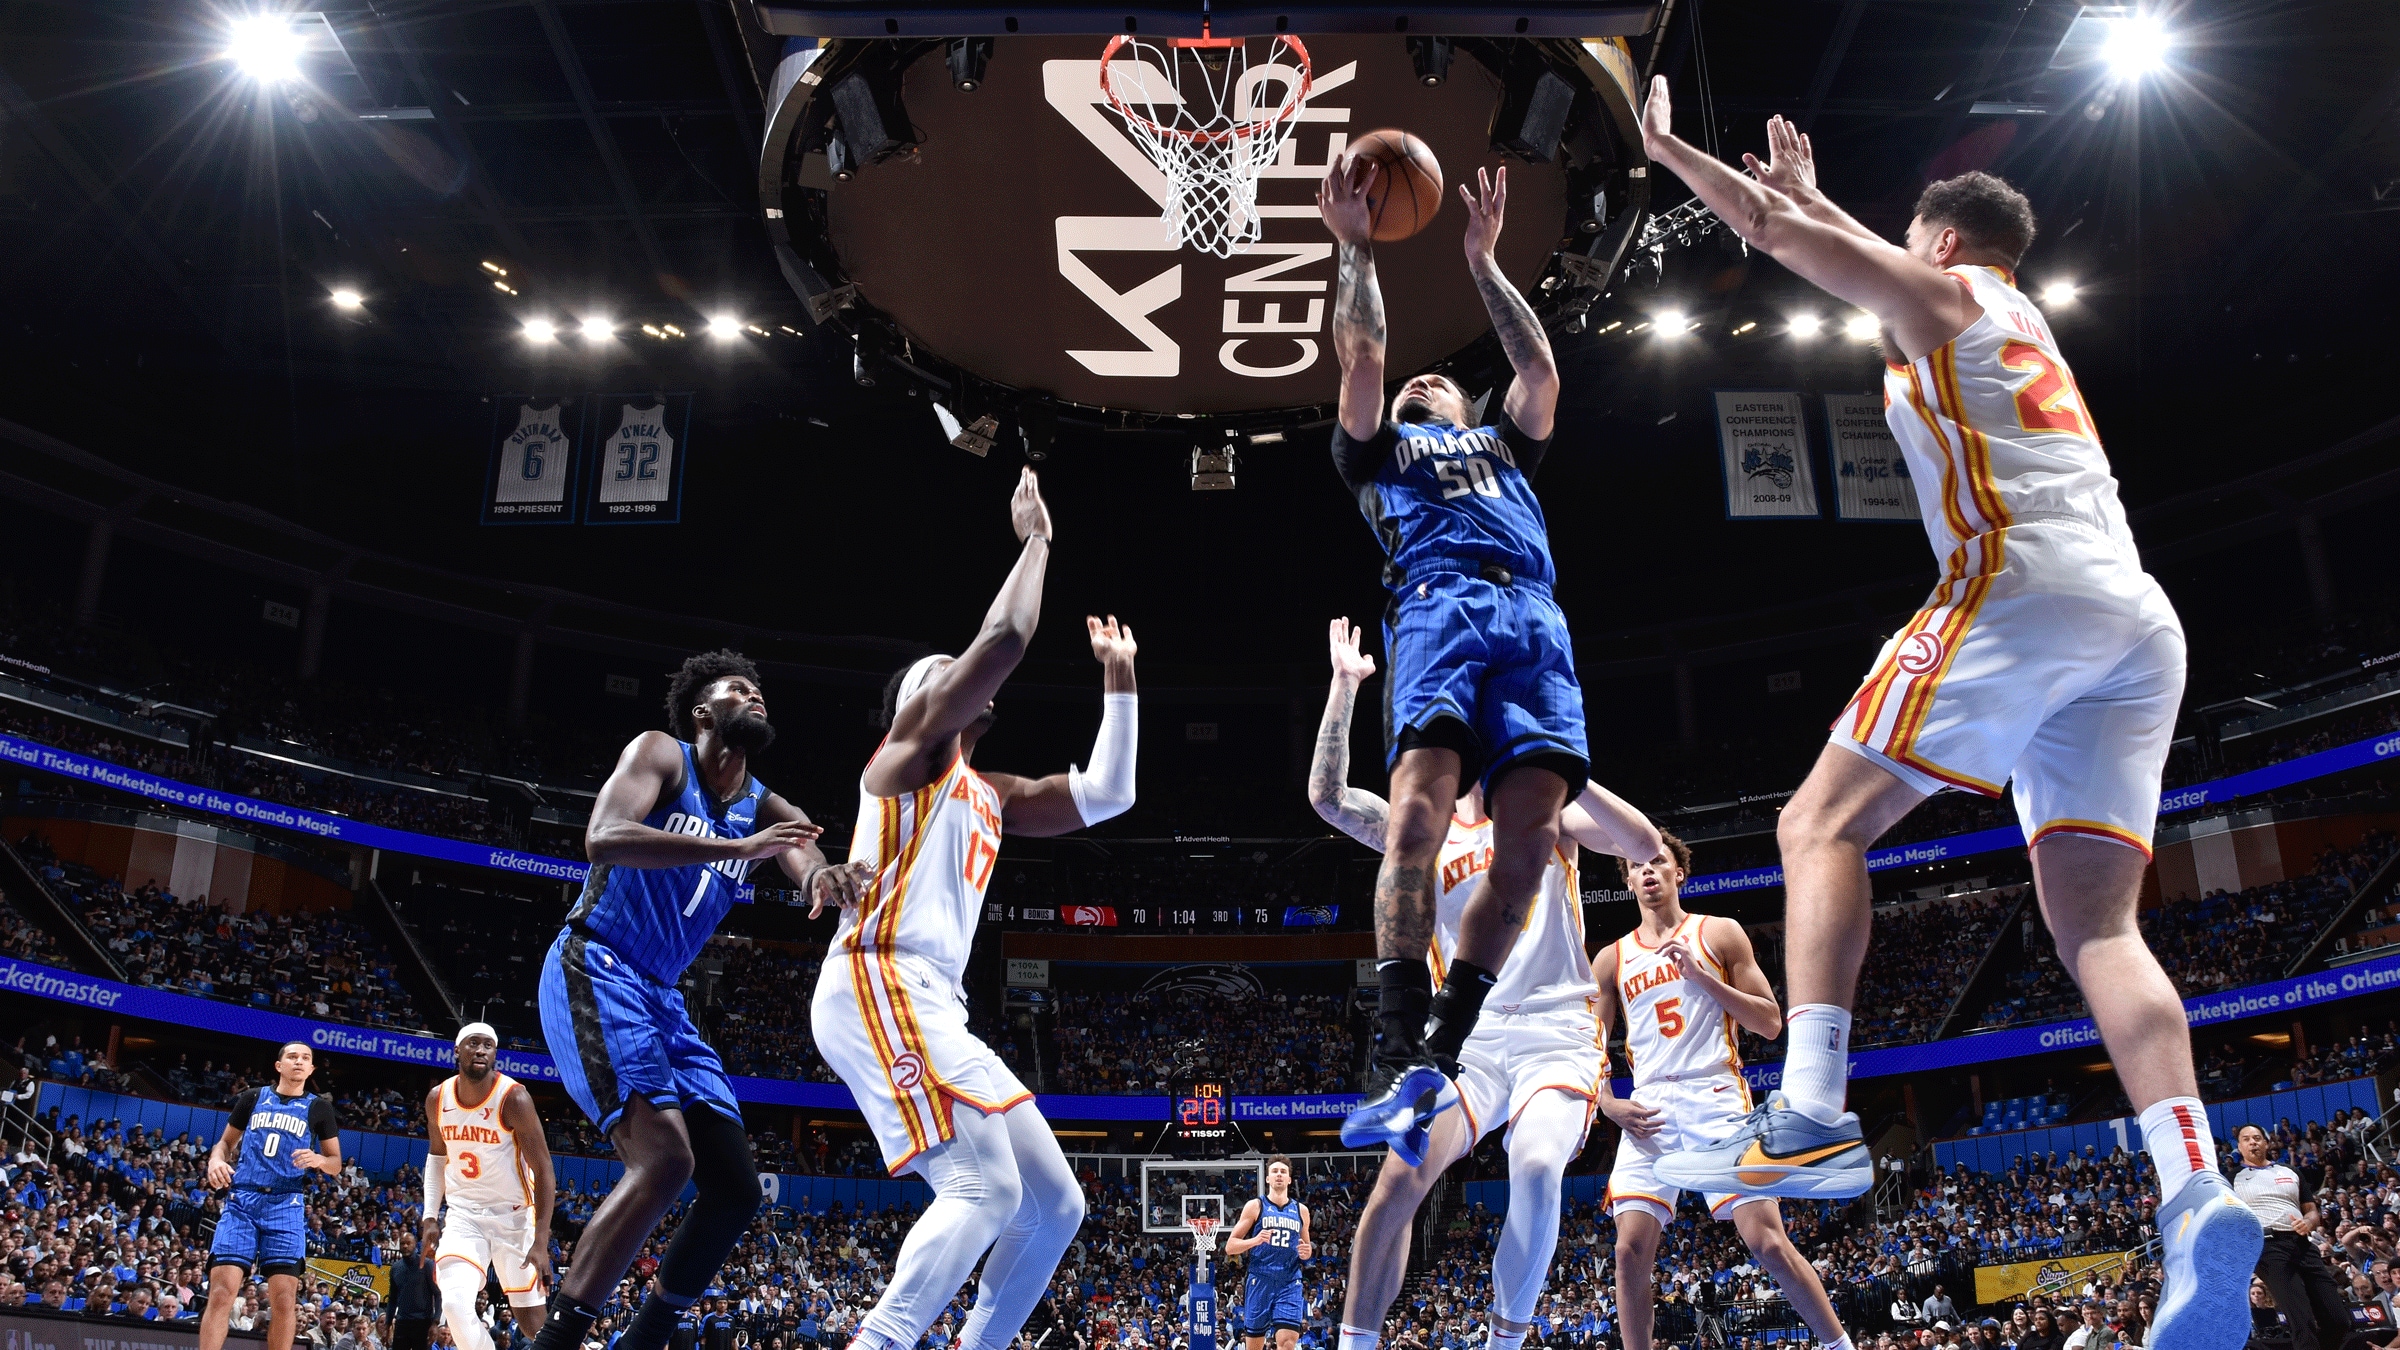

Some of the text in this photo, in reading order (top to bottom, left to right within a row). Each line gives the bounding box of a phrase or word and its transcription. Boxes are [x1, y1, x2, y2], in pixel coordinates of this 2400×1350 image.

[1219, 60, 1358, 378] CENTER
[1999, 338, 2101, 443] 2
[1736, 404, 1784, 412] EASTERN
[1844, 407, 1885, 415] EASTER
[1726, 416, 1798, 425] CONFERENCE
[1836, 419, 1887, 428] CONFERE
[621, 424, 661, 439] O'NEAL
[1732, 429, 1795, 438] CHAMPIONS
[1842, 431, 1895, 440] CHAMPION
[522, 441, 546, 481] 6
[615, 441, 660, 481] 32
[1395, 432, 1516, 475] ORLANDO
[1432, 457, 1501, 500] 50
[1754, 494, 1791, 503] 2008-09
[1863, 498, 1900, 506] 1994-95
[493, 504, 563, 514] 1989-PRESENT
[609, 504, 657, 514] 1992-1996
[42, 752, 90, 777] Ticket
[92, 765, 185, 801] Marketplace
[188, 792, 205, 806] of
[206, 796, 232, 812] the
[235, 801, 295, 826] Orlando
[297, 815, 341, 836] Magic
[1182, 835, 1230, 843] AdventHealth
[1904, 845, 1947, 861] Magic
[963, 829, 997, 894] 17
[1443, 846, 1495, 896] ATLA
[1718, 870, 1784, 890] Marketpla
[682, 868, 712, 918] 1
[988, 903, 1003, 912] TIME
[1007, 906, 1016, 921] 4
[1027, 910, 1050, 919] BONUS
[988, 913, 1003, 921] OUTS
[1133, 908, 1146, 924] 70
[1173, 910, 1196, 924] 1:04
[1212, 910, 1229, 922] 3RD
[1255, 908, 1268, 923] 75
[1018, 962, 1039, 970] 109A
[1017, 971, 1039, 979] 110A
[1623, 962, 1686, 1005] ATLAN
[2186, 995, 2280, 1022] arketplace
[2284, 984, 2302, 1004] of
[2306, 980, 2338, 999] the
[1654, 996, 1687, 1039] 5
[2040, 1025, 2101, 1047] Officia
[312, 1028, 378, 1053] Official
[382, 1038, 433, 1064] Ticket
[1194, 1084, 1222, 1098] 1:04
[1183, 1099, 1219, 1125] 20
[1240, 1102, 1288, 1116] Ticket
[250, 1112, 307, 1138] ORLANDO
[1190, 1130, 1227, 1138] TISSOT
[263, 1132, 281, 1158] 0
[459, 1151, 481, 1179] 3
[1262, 1216, 1301, 1233] ORLANDO
[1271, 1229, 1291, 1248] 22
[1195, 1300, 1209, 1312] GET
[1196, 1312, 1209, 1323] THE
[1199, 1323, 1212, 1336] App
